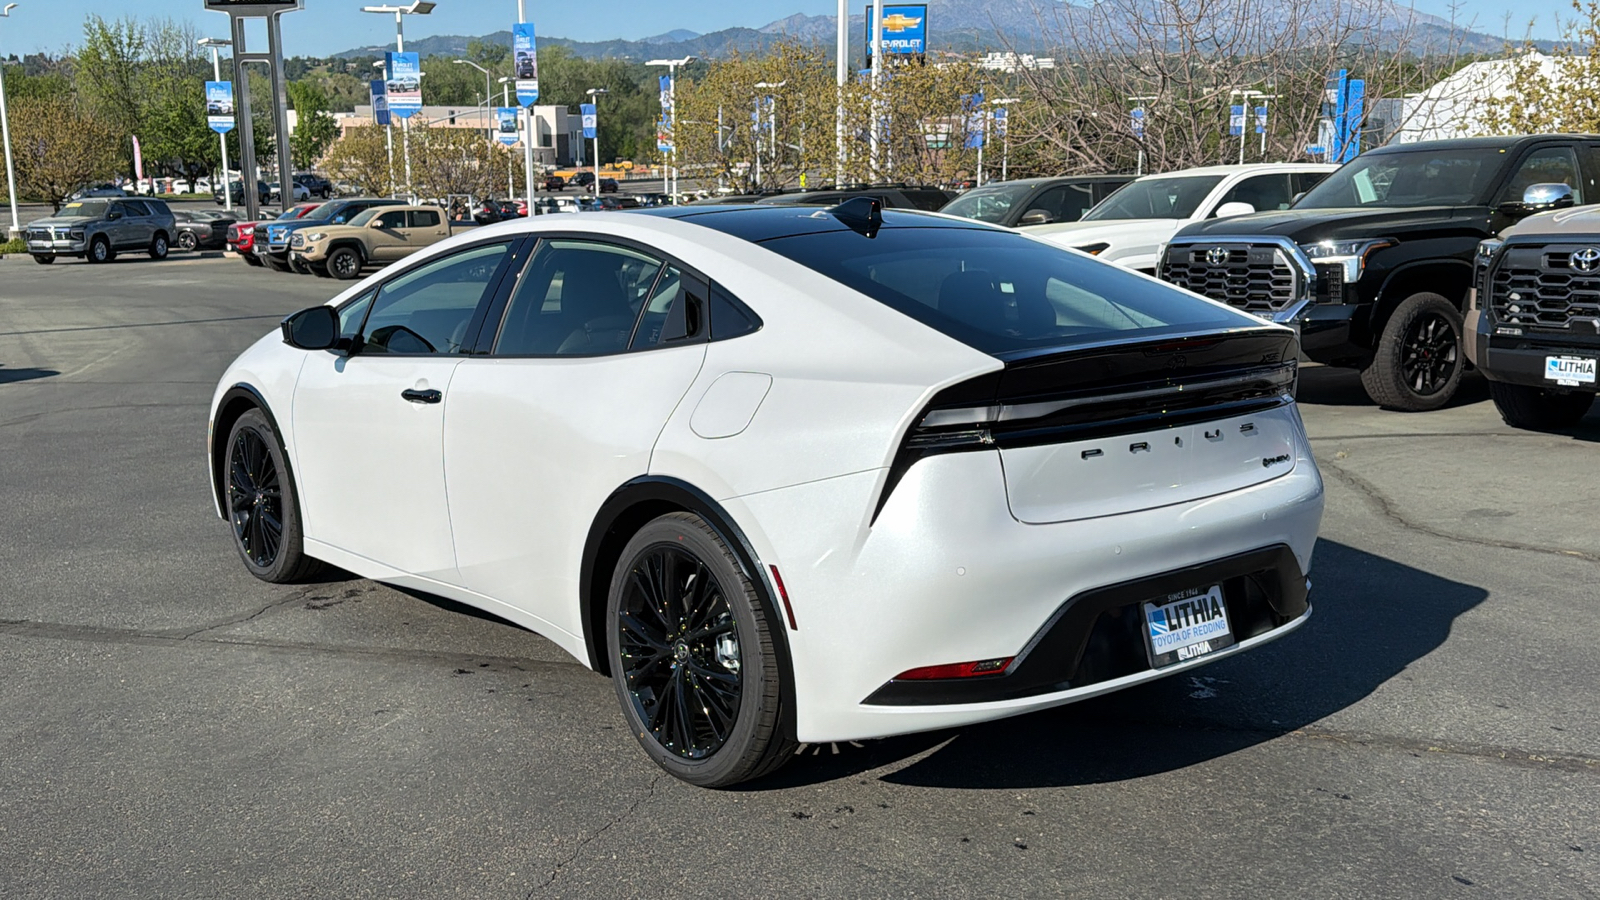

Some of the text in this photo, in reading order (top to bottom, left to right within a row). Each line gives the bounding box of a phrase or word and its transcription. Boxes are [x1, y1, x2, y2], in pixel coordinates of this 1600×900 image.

[870, 39, 921, 48] CEVROLET
[1559, 361, 1594, 374] LITHIA
[1081, 422, 1254, 460] PRIUS
[1168, 593, 1185, 602] SINCE
[1165, 595, 1223, 631] LITHIA
[1153, 619, 1226, 647] TOYOTA OF REDDING
[1185, 640, 1212, 657] LITHIA
